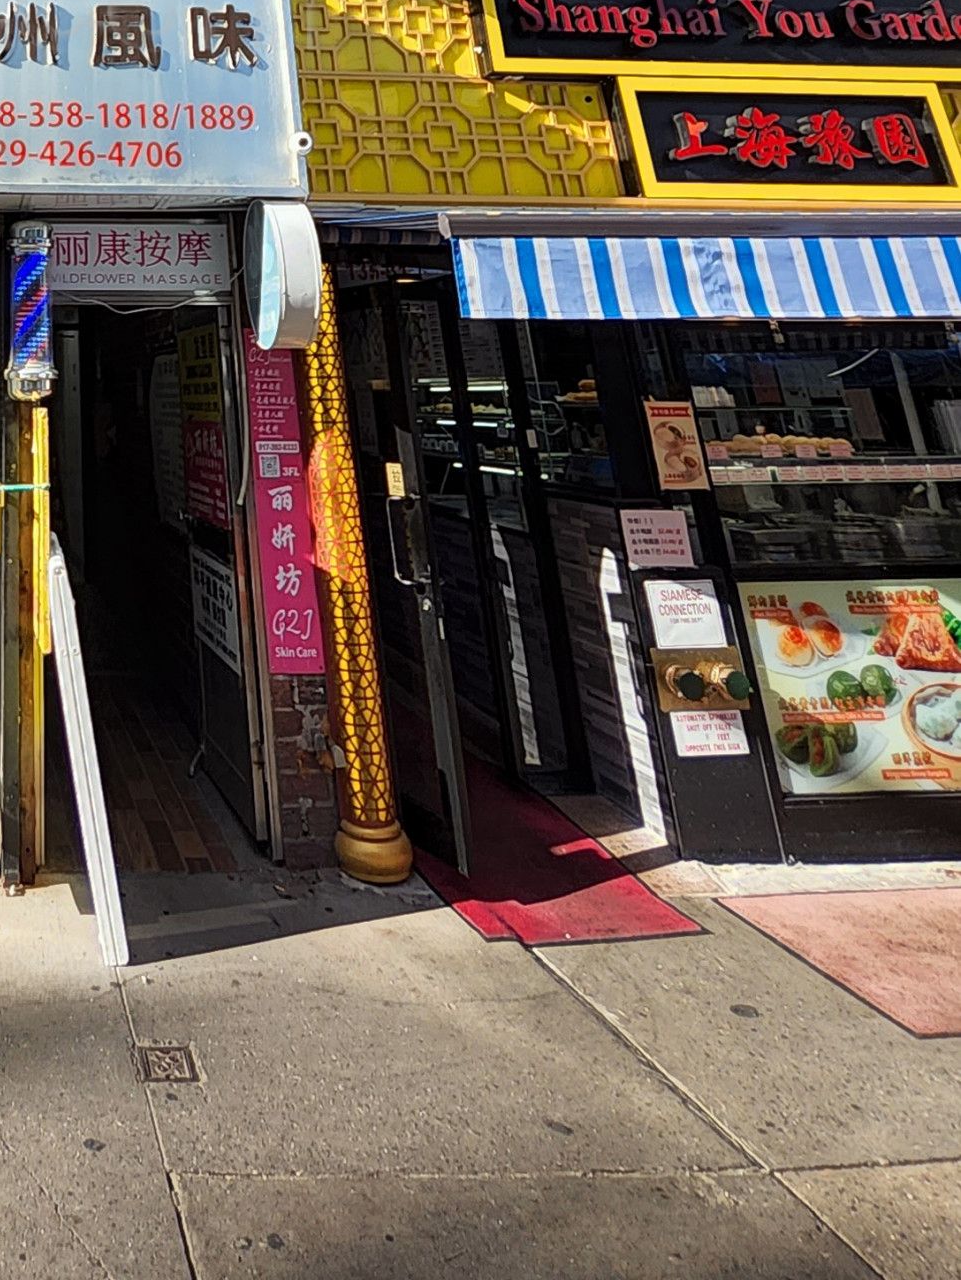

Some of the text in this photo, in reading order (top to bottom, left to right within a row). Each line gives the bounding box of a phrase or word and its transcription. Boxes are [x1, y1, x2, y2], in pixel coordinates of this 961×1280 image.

[670, 107, 929, 170] 上海豫園
[143, 273, 223, 285] MASSAGE
[660, 587, 704, 601] SIAMESE
[658, 603, 712, 616] CONNECTION
[275, 646, 317, 658] Skin Care
